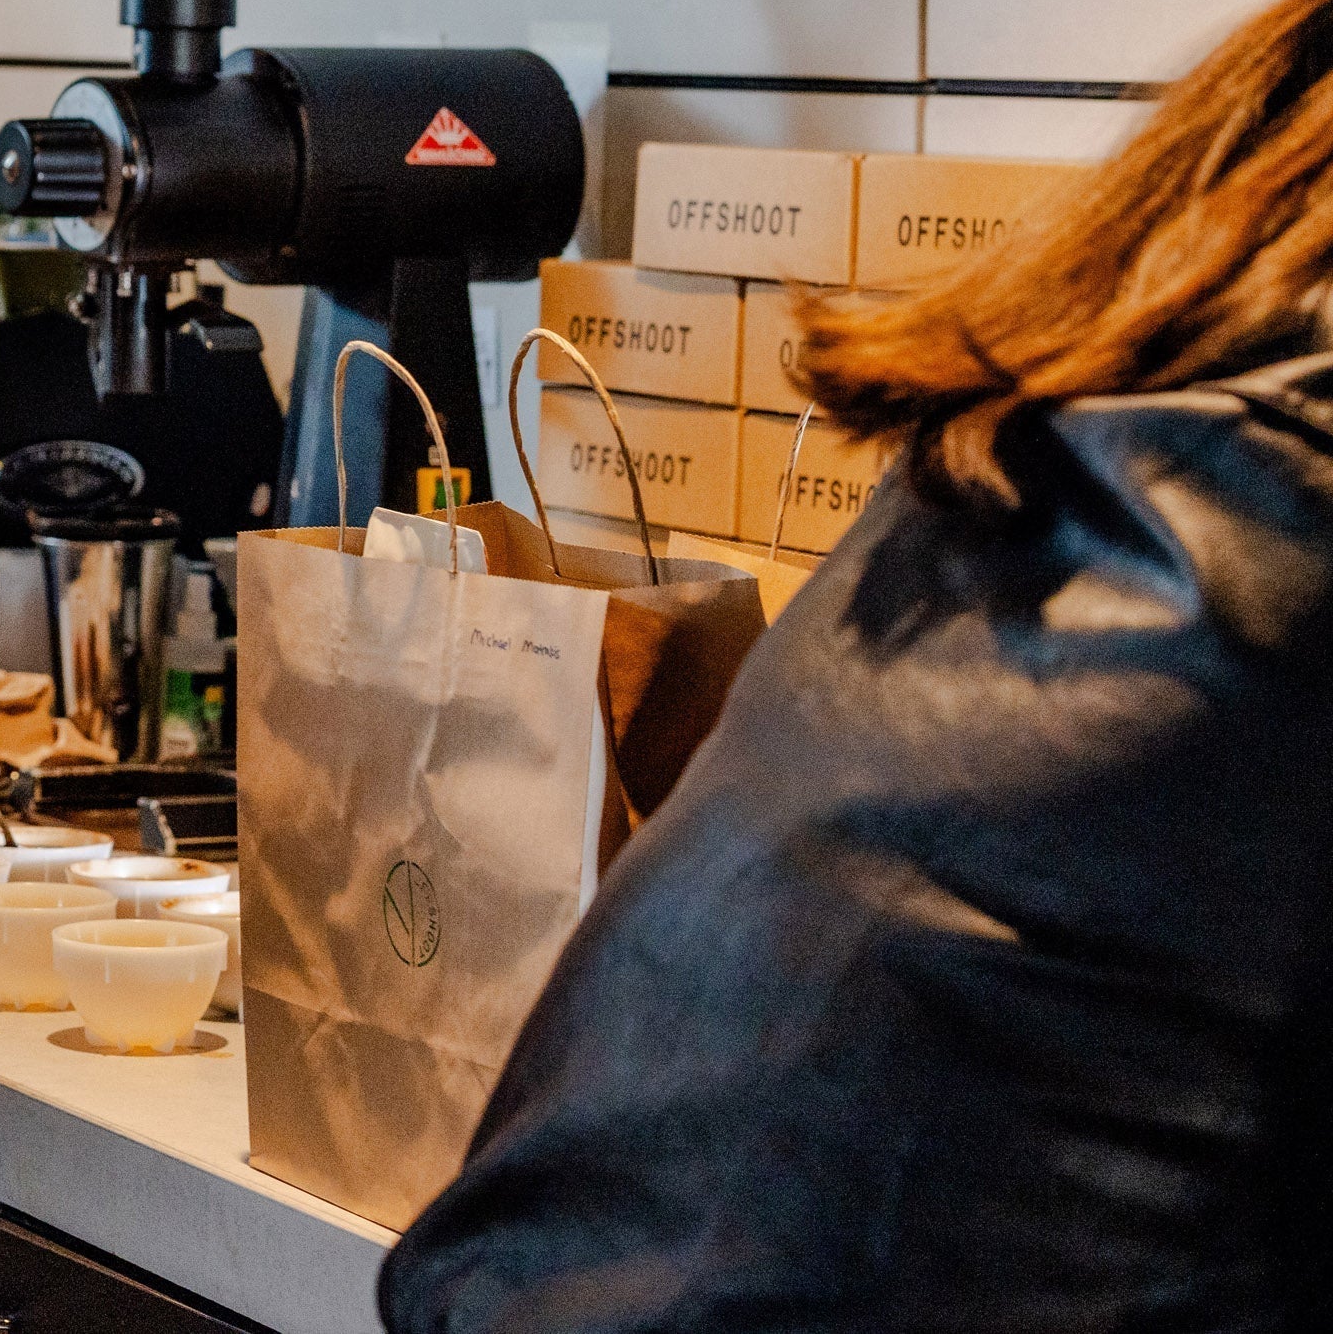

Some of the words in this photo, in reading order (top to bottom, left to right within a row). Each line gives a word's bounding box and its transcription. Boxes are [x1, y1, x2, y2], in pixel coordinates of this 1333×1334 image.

[668, 200, 801, 237] OFFSHOOT
[897, 214, 1023, 250] OFFSHO
[569, 315, 691, 354] OFFSHOOT
[571, 443, 692, 485] OFFSHOOT
